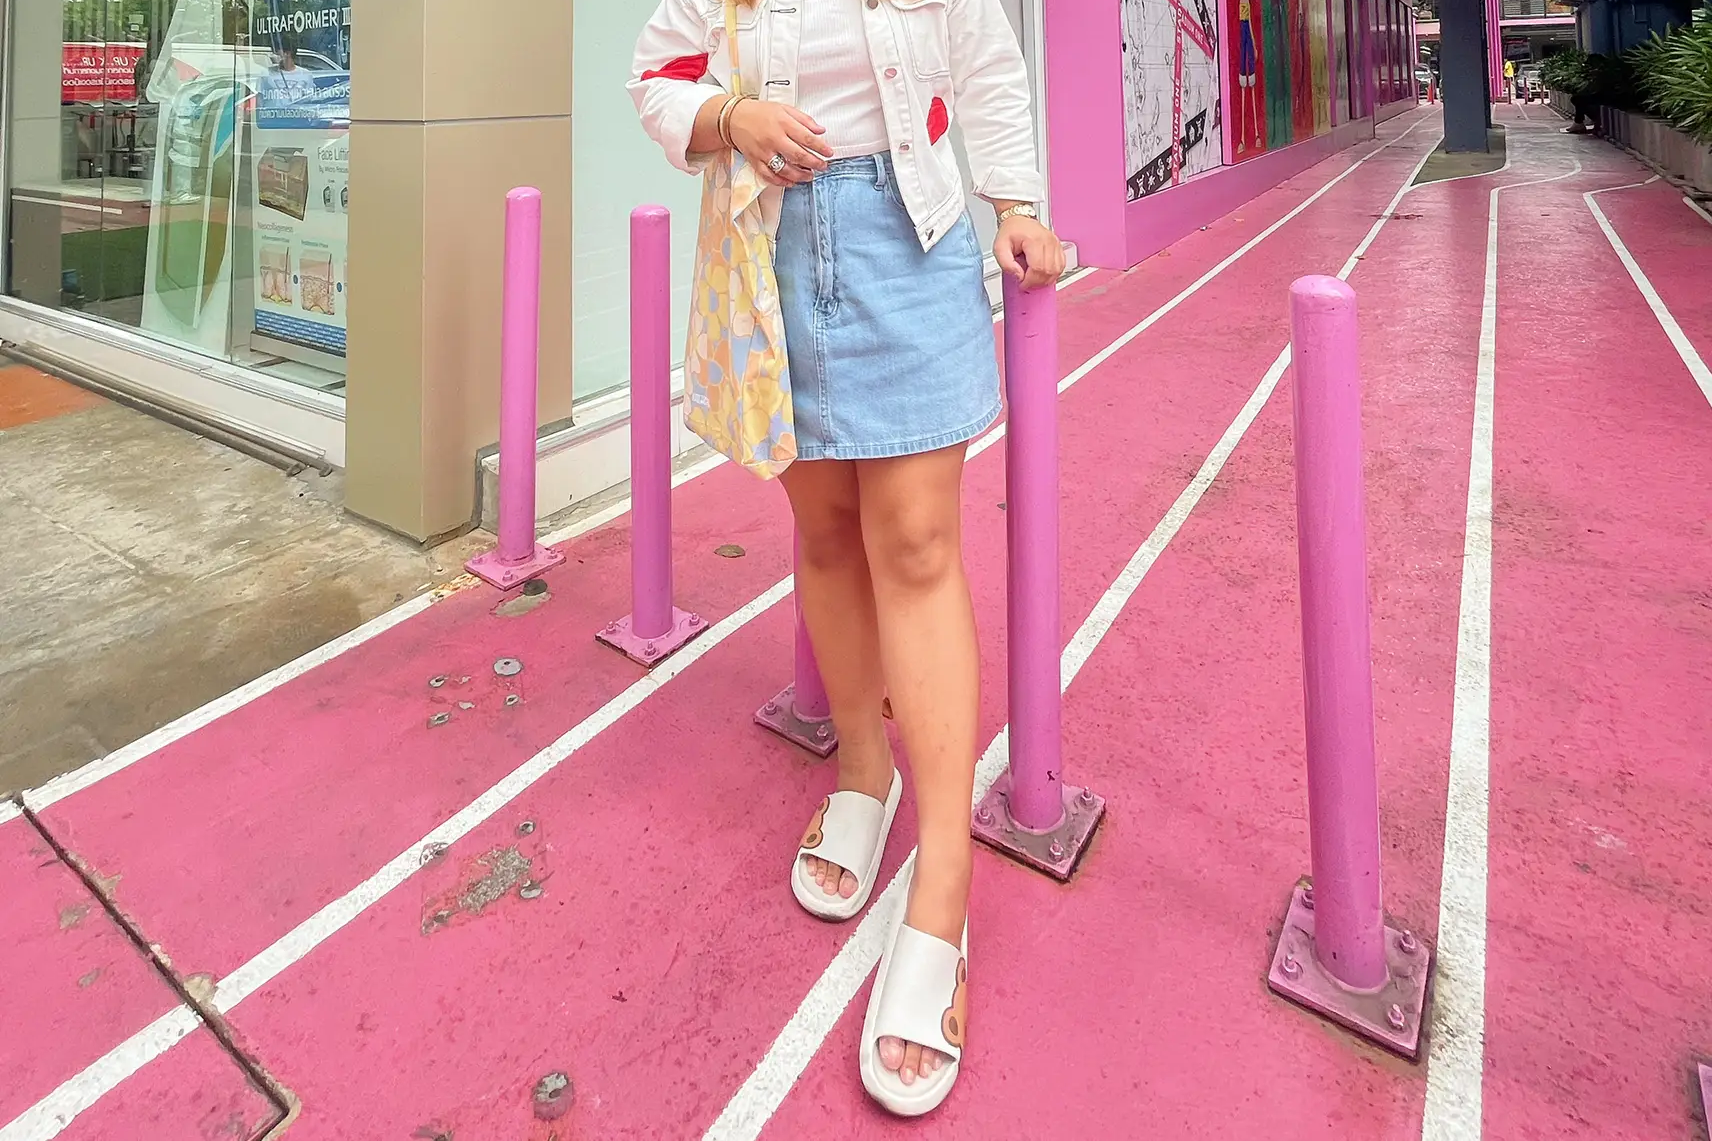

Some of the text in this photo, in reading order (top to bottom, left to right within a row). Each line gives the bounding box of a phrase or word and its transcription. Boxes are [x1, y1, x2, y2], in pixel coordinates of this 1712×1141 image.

[256, 8, 338, 35] ULTRAFORMER
[317, 147, 333, 161] Face
[1172, 113, 1182, 180] STADIUM
